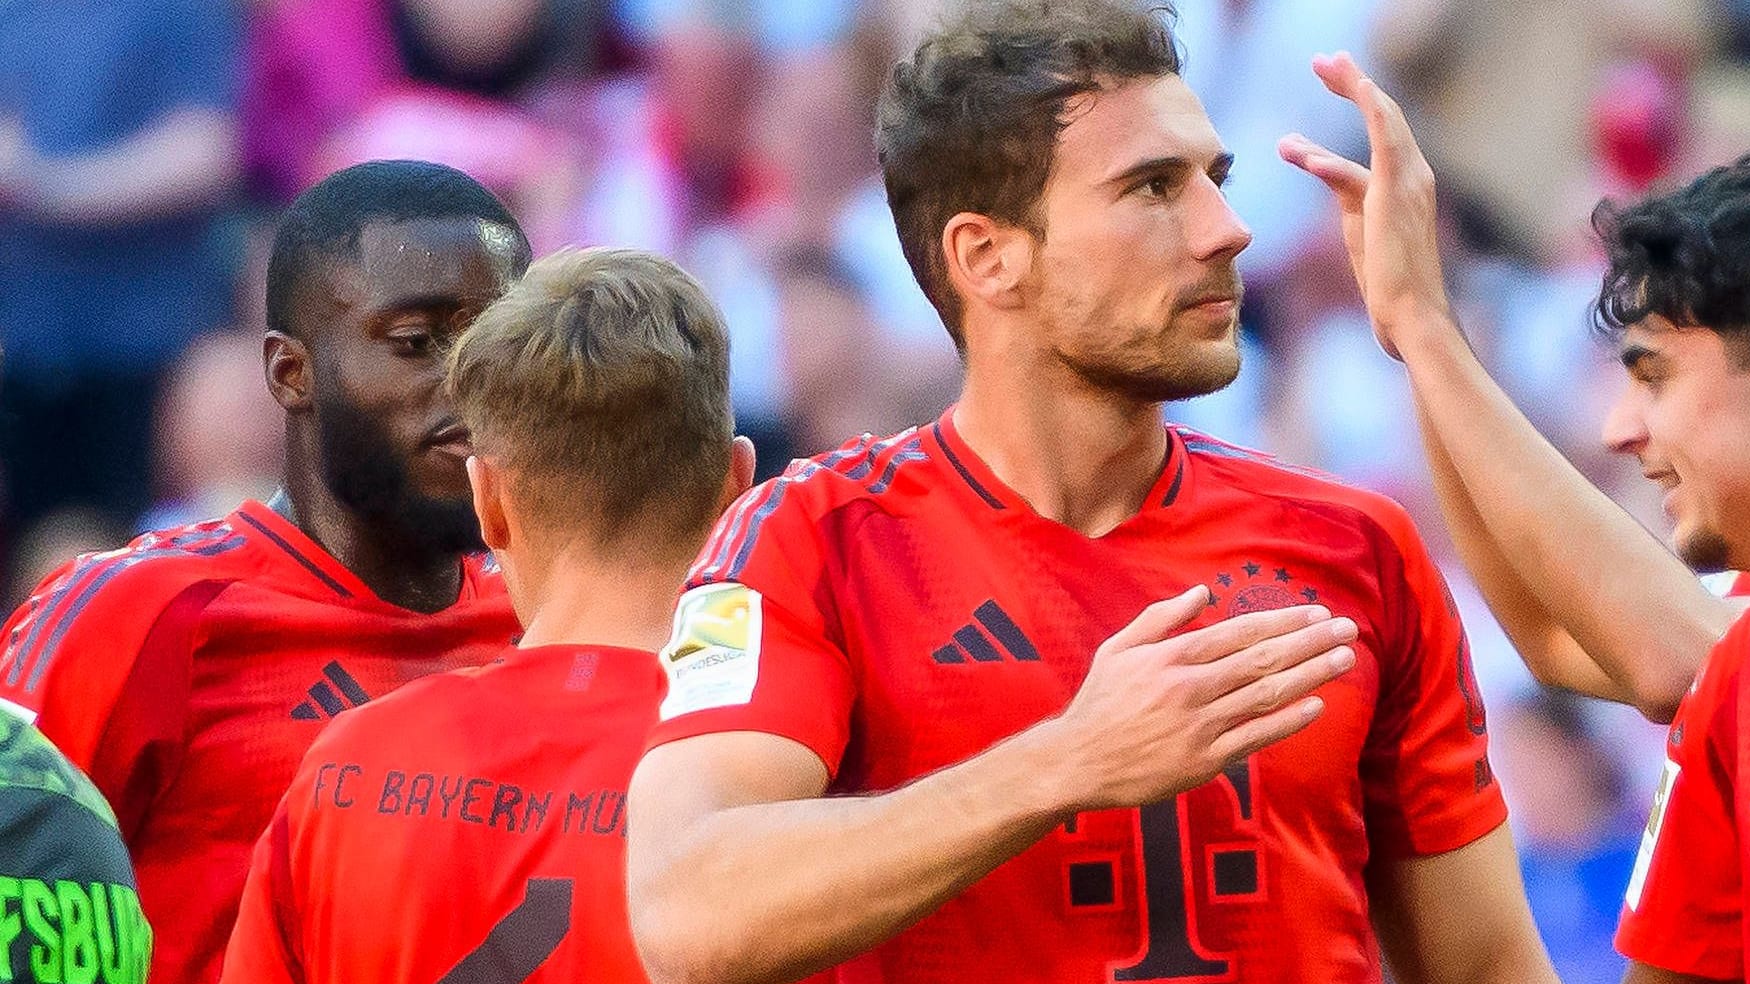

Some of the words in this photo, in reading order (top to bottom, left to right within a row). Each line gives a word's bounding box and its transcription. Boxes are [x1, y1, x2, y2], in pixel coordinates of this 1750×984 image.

[314, 763, 362, 808] FC
[377, 770, 553, 834] BAYERN
[563, 789, 629, 838] MÜ
